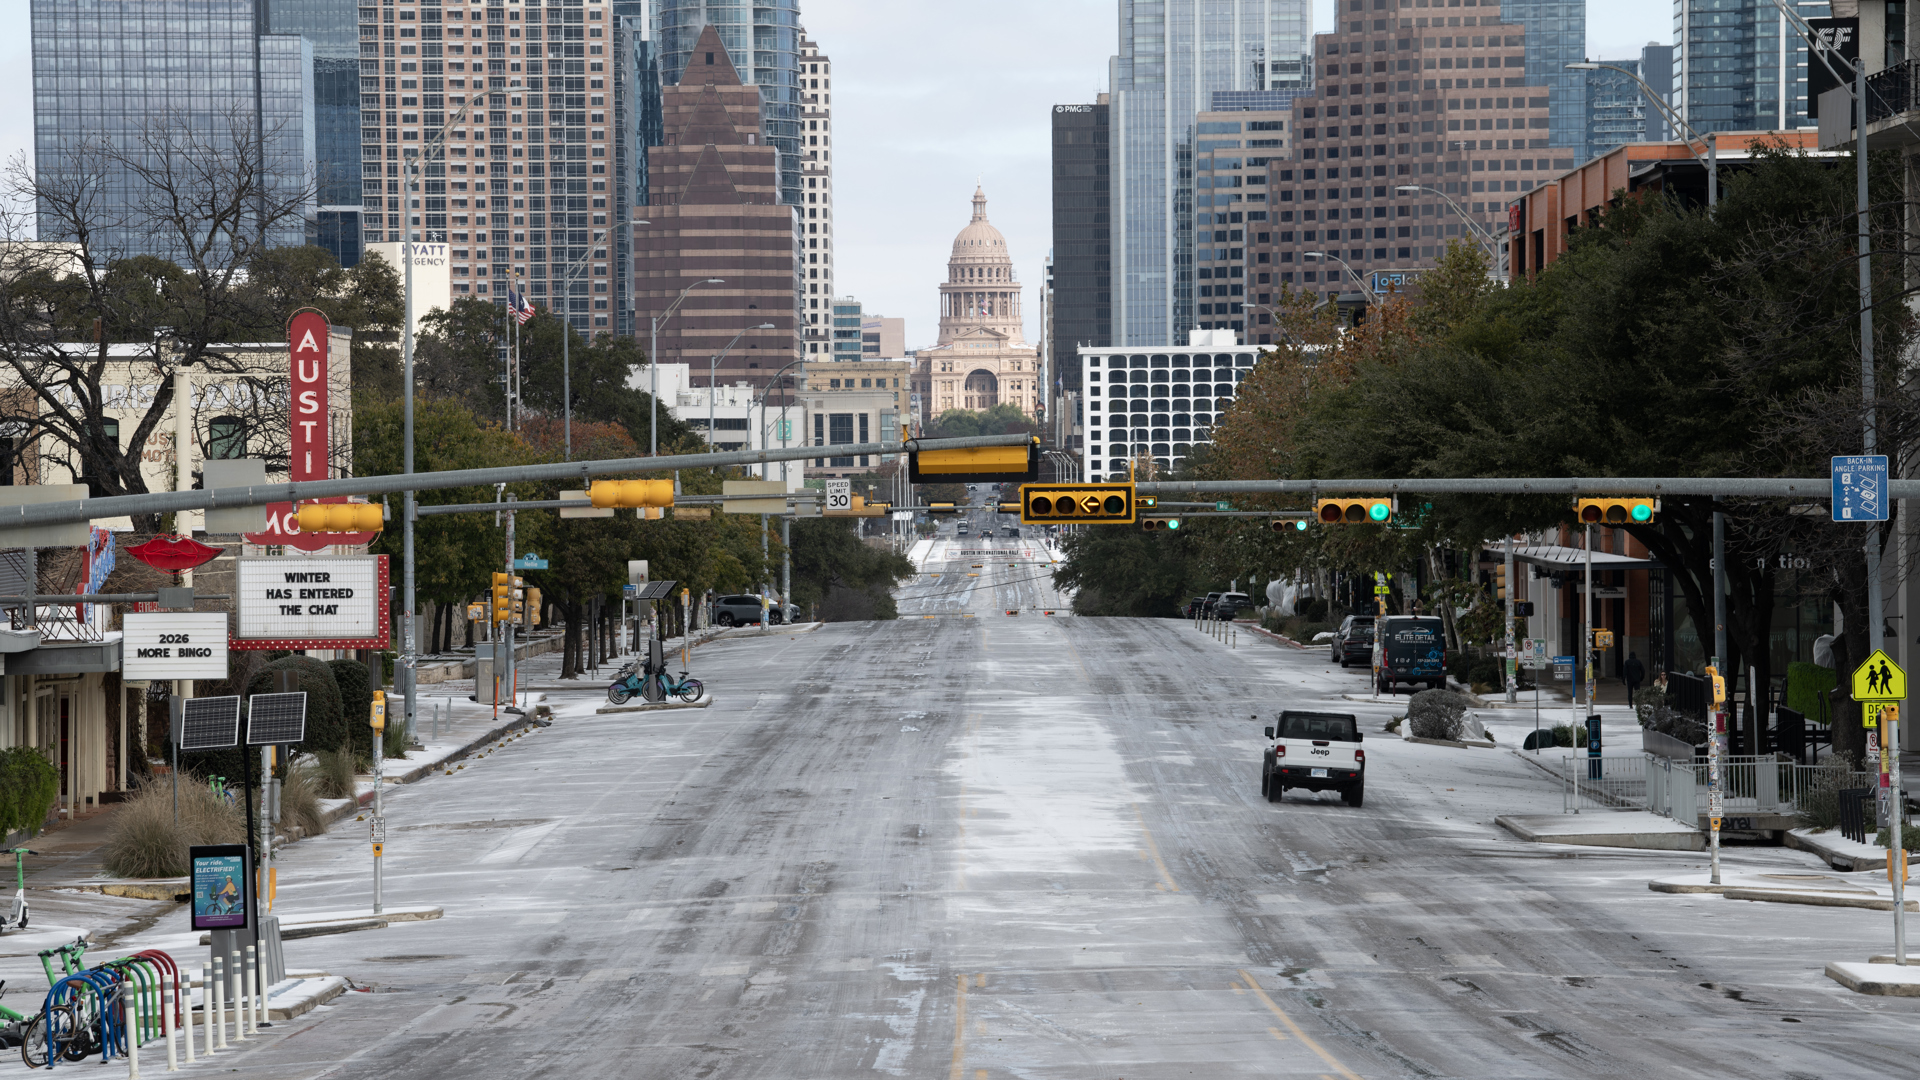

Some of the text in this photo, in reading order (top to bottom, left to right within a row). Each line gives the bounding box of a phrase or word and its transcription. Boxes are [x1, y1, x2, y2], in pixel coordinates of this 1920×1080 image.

[1064, 105, 1082, 113] PMG
[402, 257, 445, 266] RGENCY
[296, 328, 320, 504] AUSTI
[1834, 465, 1855, 473] ANGLE
[829, 494, 848, 507] 30
[284, 572, 331, 583] WINTER
[266, 588, 354, 599] HAS ENTERED
[279, 604, 339, 615] THE CHAT
[159, 634, 190, 644] 2026
[137, 648, 212, 658] MORE BINGO
[1310, 748, 1330, 756] Jeep
